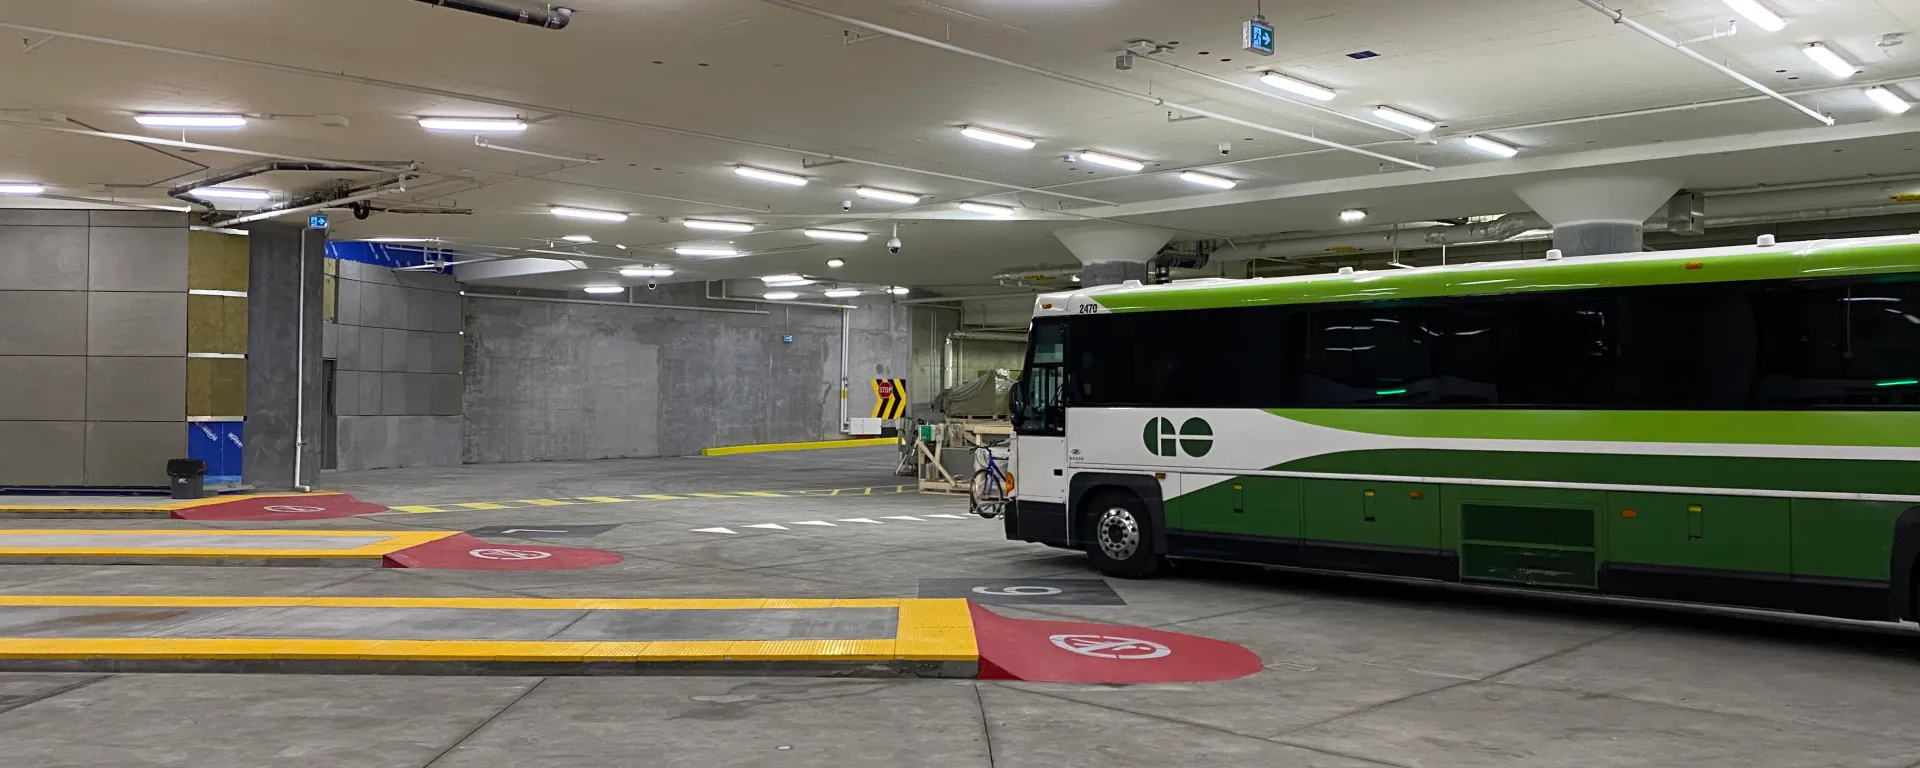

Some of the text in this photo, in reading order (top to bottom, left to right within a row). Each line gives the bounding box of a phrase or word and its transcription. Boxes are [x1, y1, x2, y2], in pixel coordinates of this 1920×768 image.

[1079, 303, 1098, 314] 2470
[879, 386, 893, 394] STOP
[1143, 416, 1214, 458] GO
